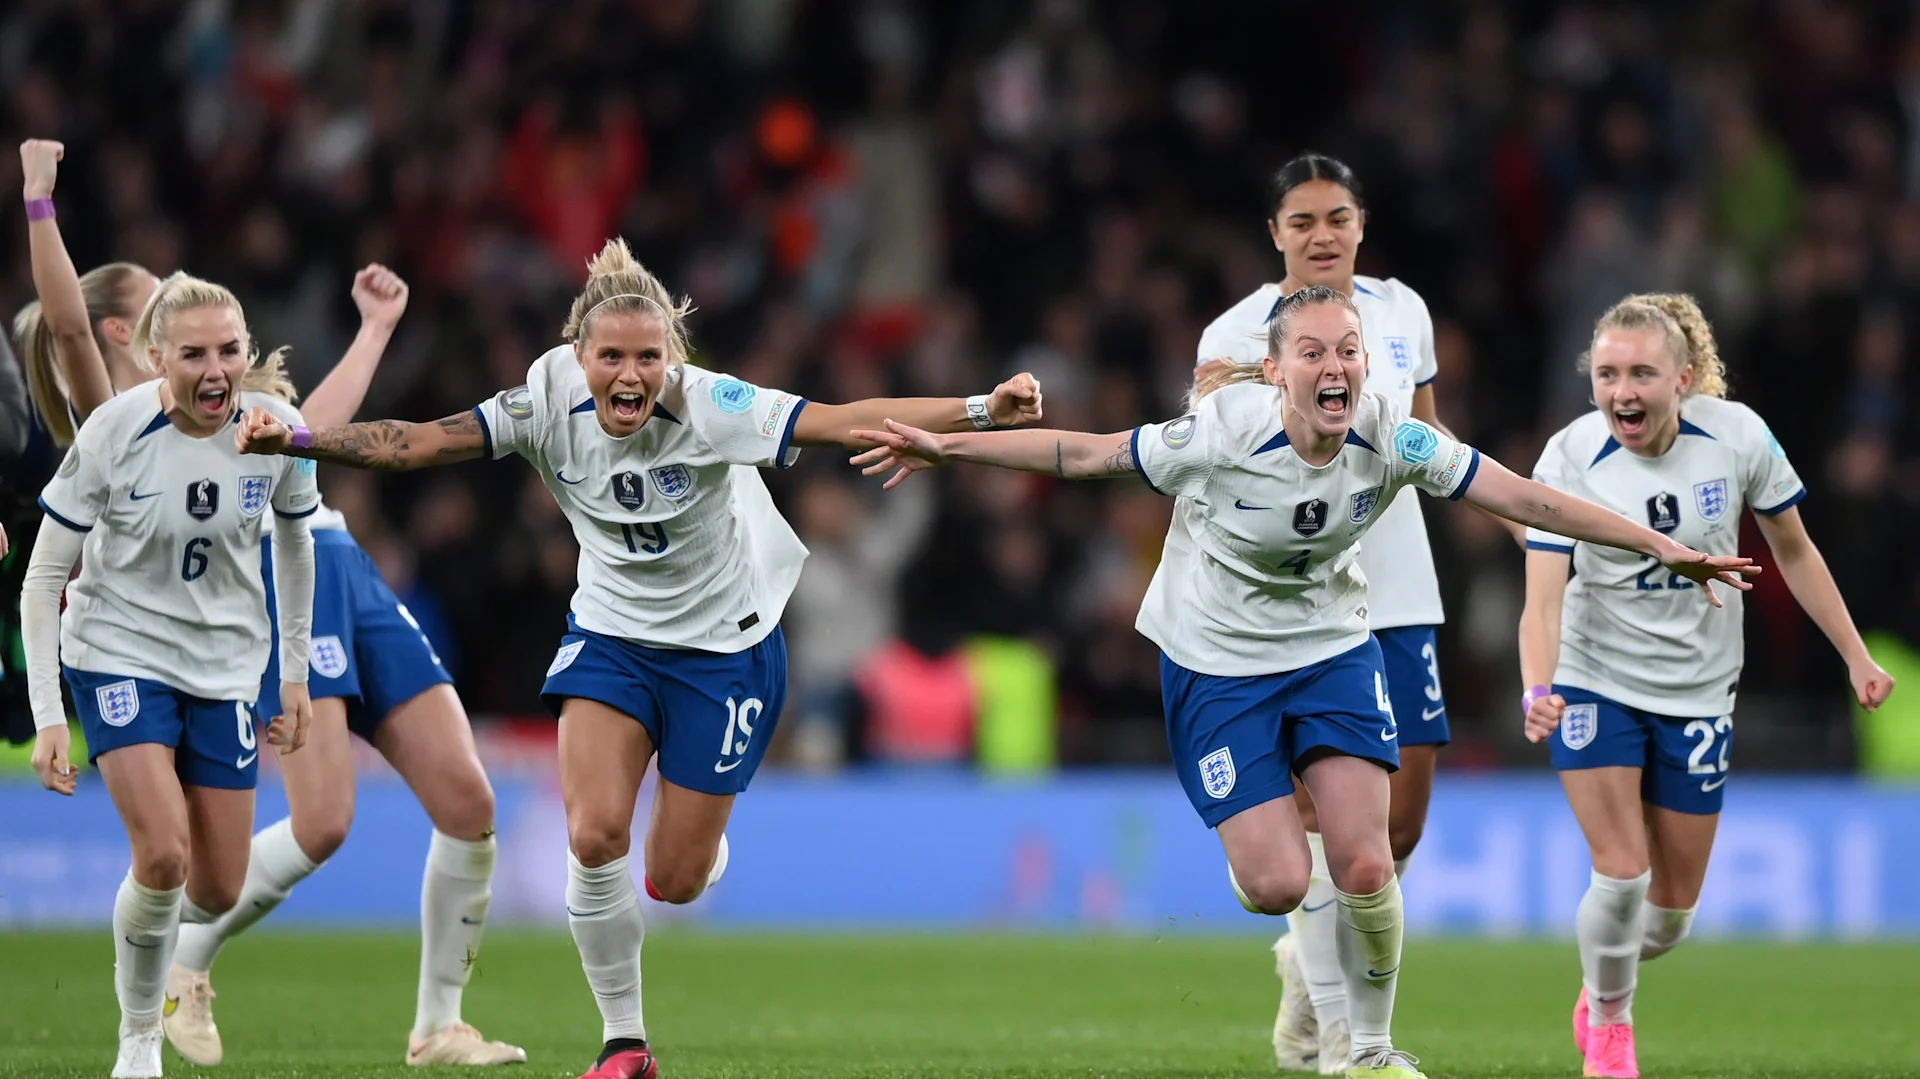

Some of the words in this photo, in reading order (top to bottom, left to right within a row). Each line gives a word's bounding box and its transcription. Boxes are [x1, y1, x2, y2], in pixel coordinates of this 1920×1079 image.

[181, 537, 213, 582] 6
[621, 522, 669, 554] 19
[1277, 549, 1312, 575] 4
[1374, 670, 1397, 727] 4
[1421, 642, 1443, 702] 3
[236, 700, 256, 751] 6
[720, 696, 764, 756] 19
[1683, 714, 1733, 774] 22
